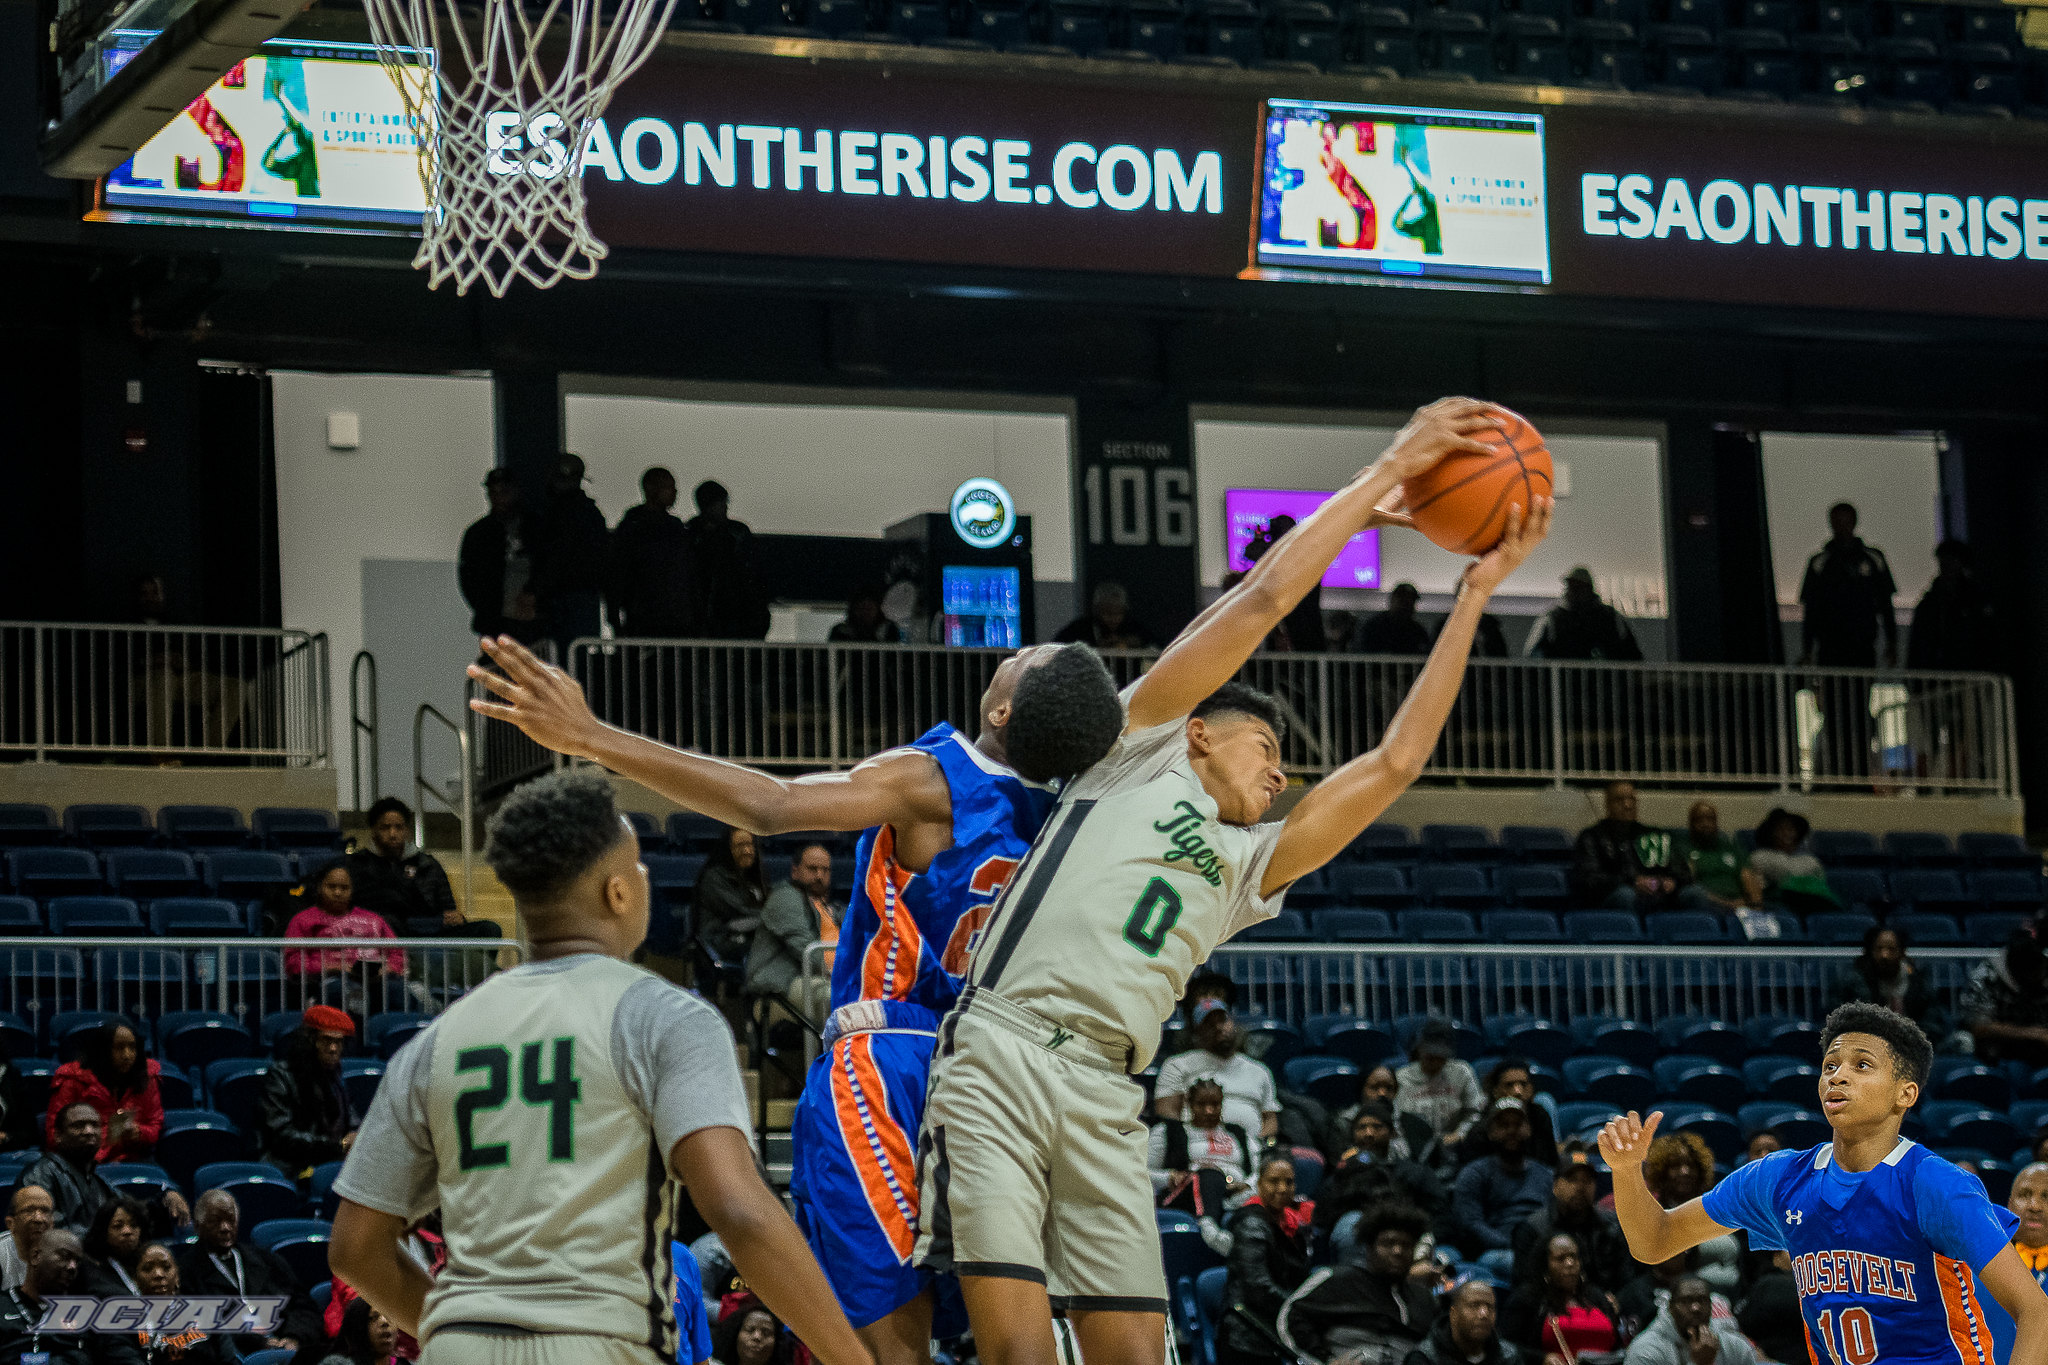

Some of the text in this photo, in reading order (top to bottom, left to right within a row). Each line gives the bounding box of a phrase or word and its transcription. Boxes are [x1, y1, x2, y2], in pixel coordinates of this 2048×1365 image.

[484, 110, 1224, 215] ESAONTHERISE.COM
[1581, 173, 2048, 261] ESAONTHERISE
[1102, 440, 1171, 460] SECTION
[1084, 464, 1194, 547] 106
[1153, 799, 1225, 888] Tigers
[1122, 875, 1184, 959] 0
[454, 1034, 583, 1175] 24
[1791, 1249, 1918, 1303] OOSEVELT
[1817, 1306, 1879, 1365] 10
